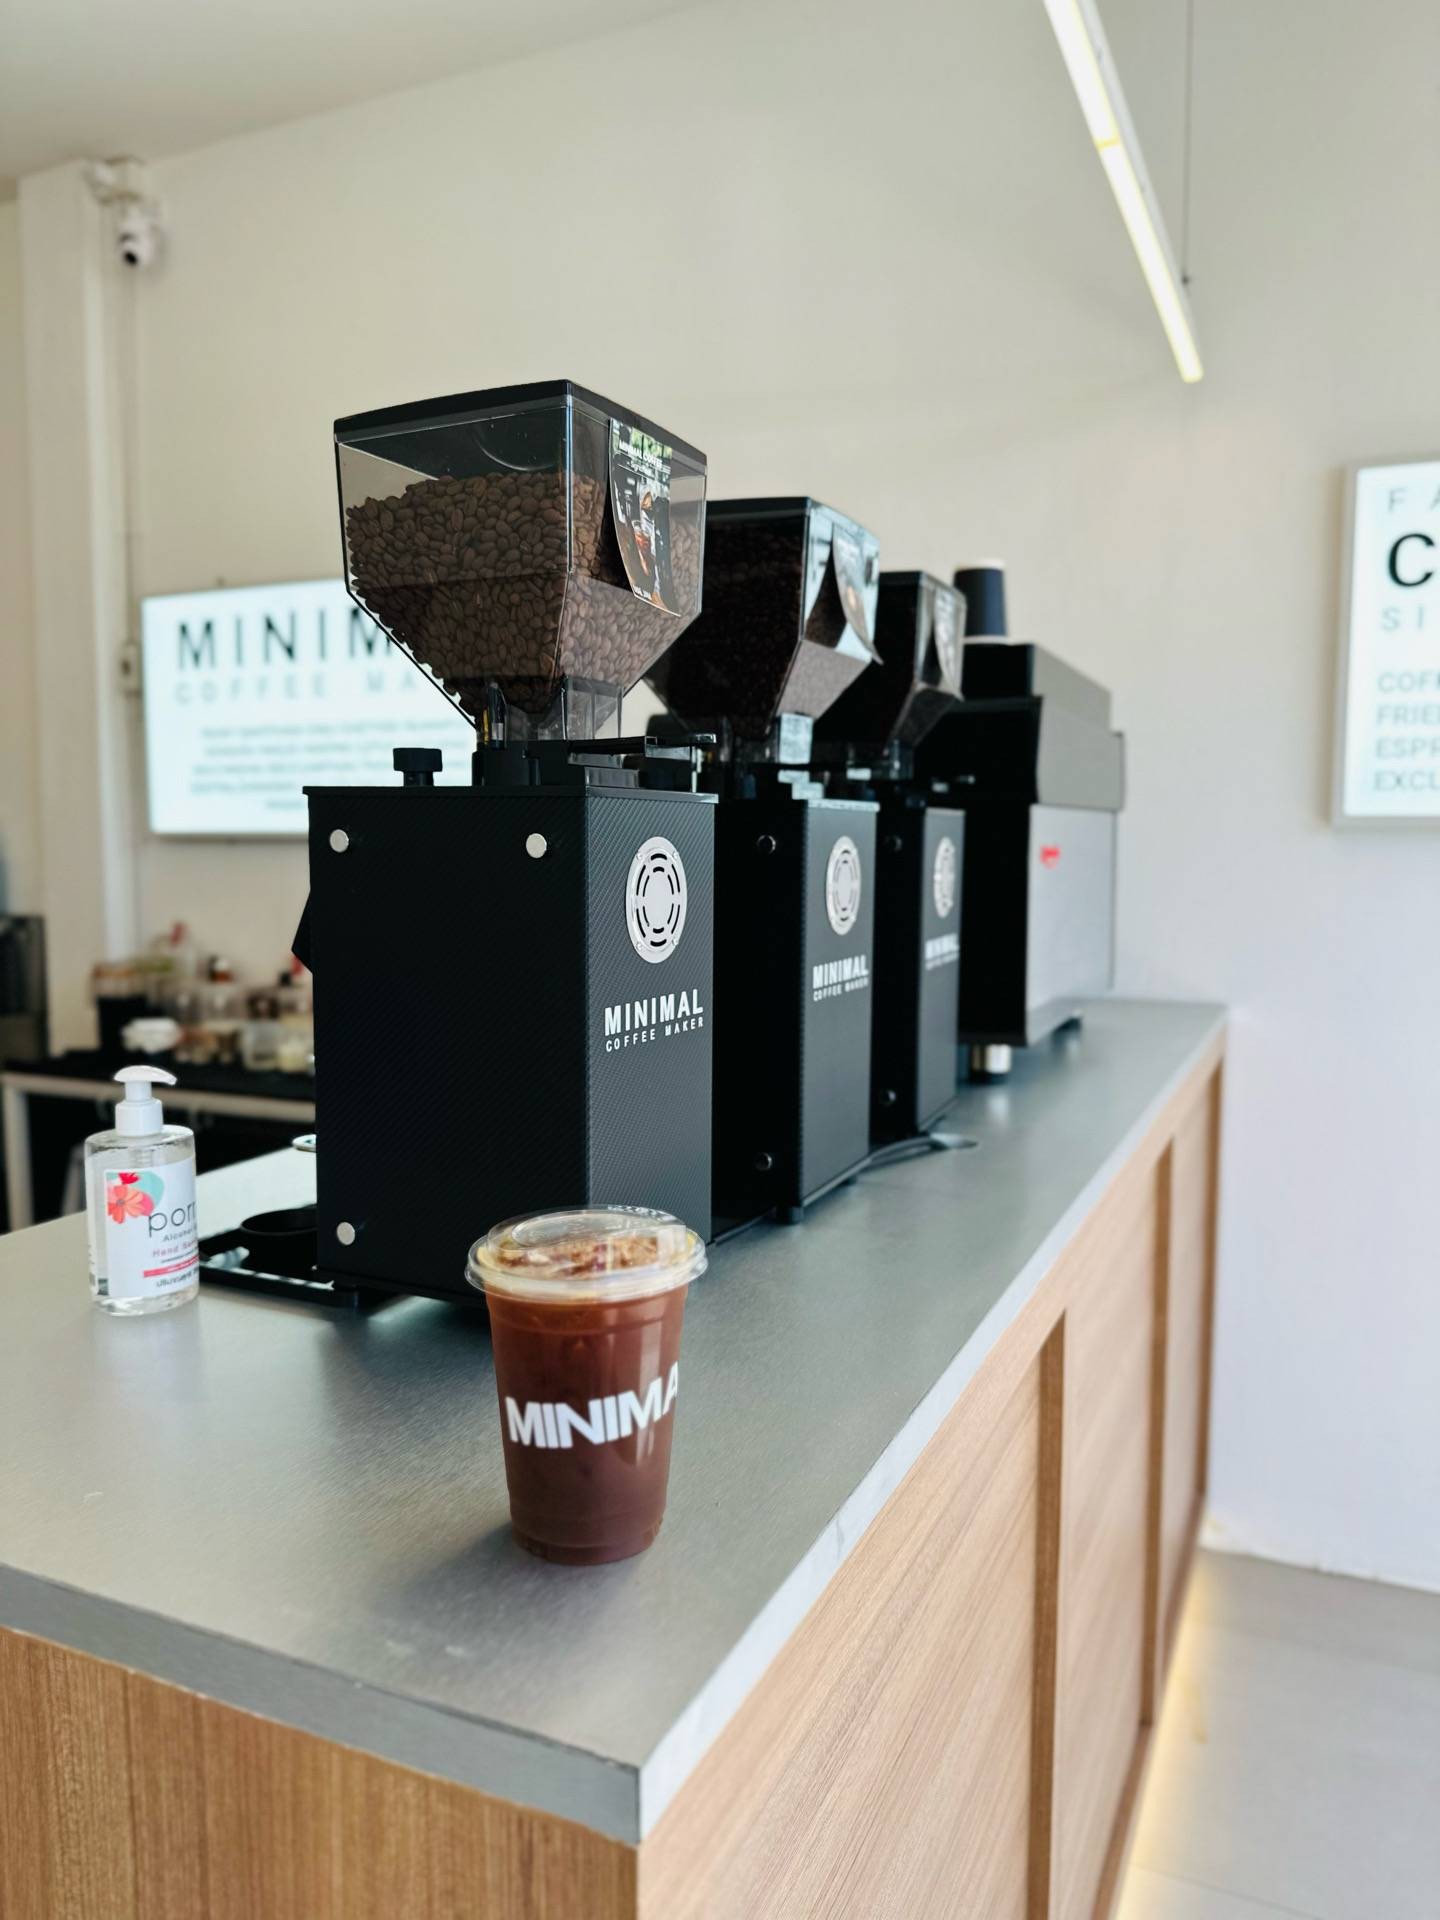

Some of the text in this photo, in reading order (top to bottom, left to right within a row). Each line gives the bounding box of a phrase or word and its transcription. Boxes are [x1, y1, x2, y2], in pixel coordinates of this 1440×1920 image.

[176, 672, 327, 705] COFFEE
[1378, 671, 1440, 692] COF
[813, 954, 868, 990] MINIMAL
[813, 984, 842, 1002] COFFEE
[605, 988, 703, 1036] MINIMAL
[606, 1016, 703, 1053] COFFEE MAKER
[505, 1361, 678, 1448] MINIMA
